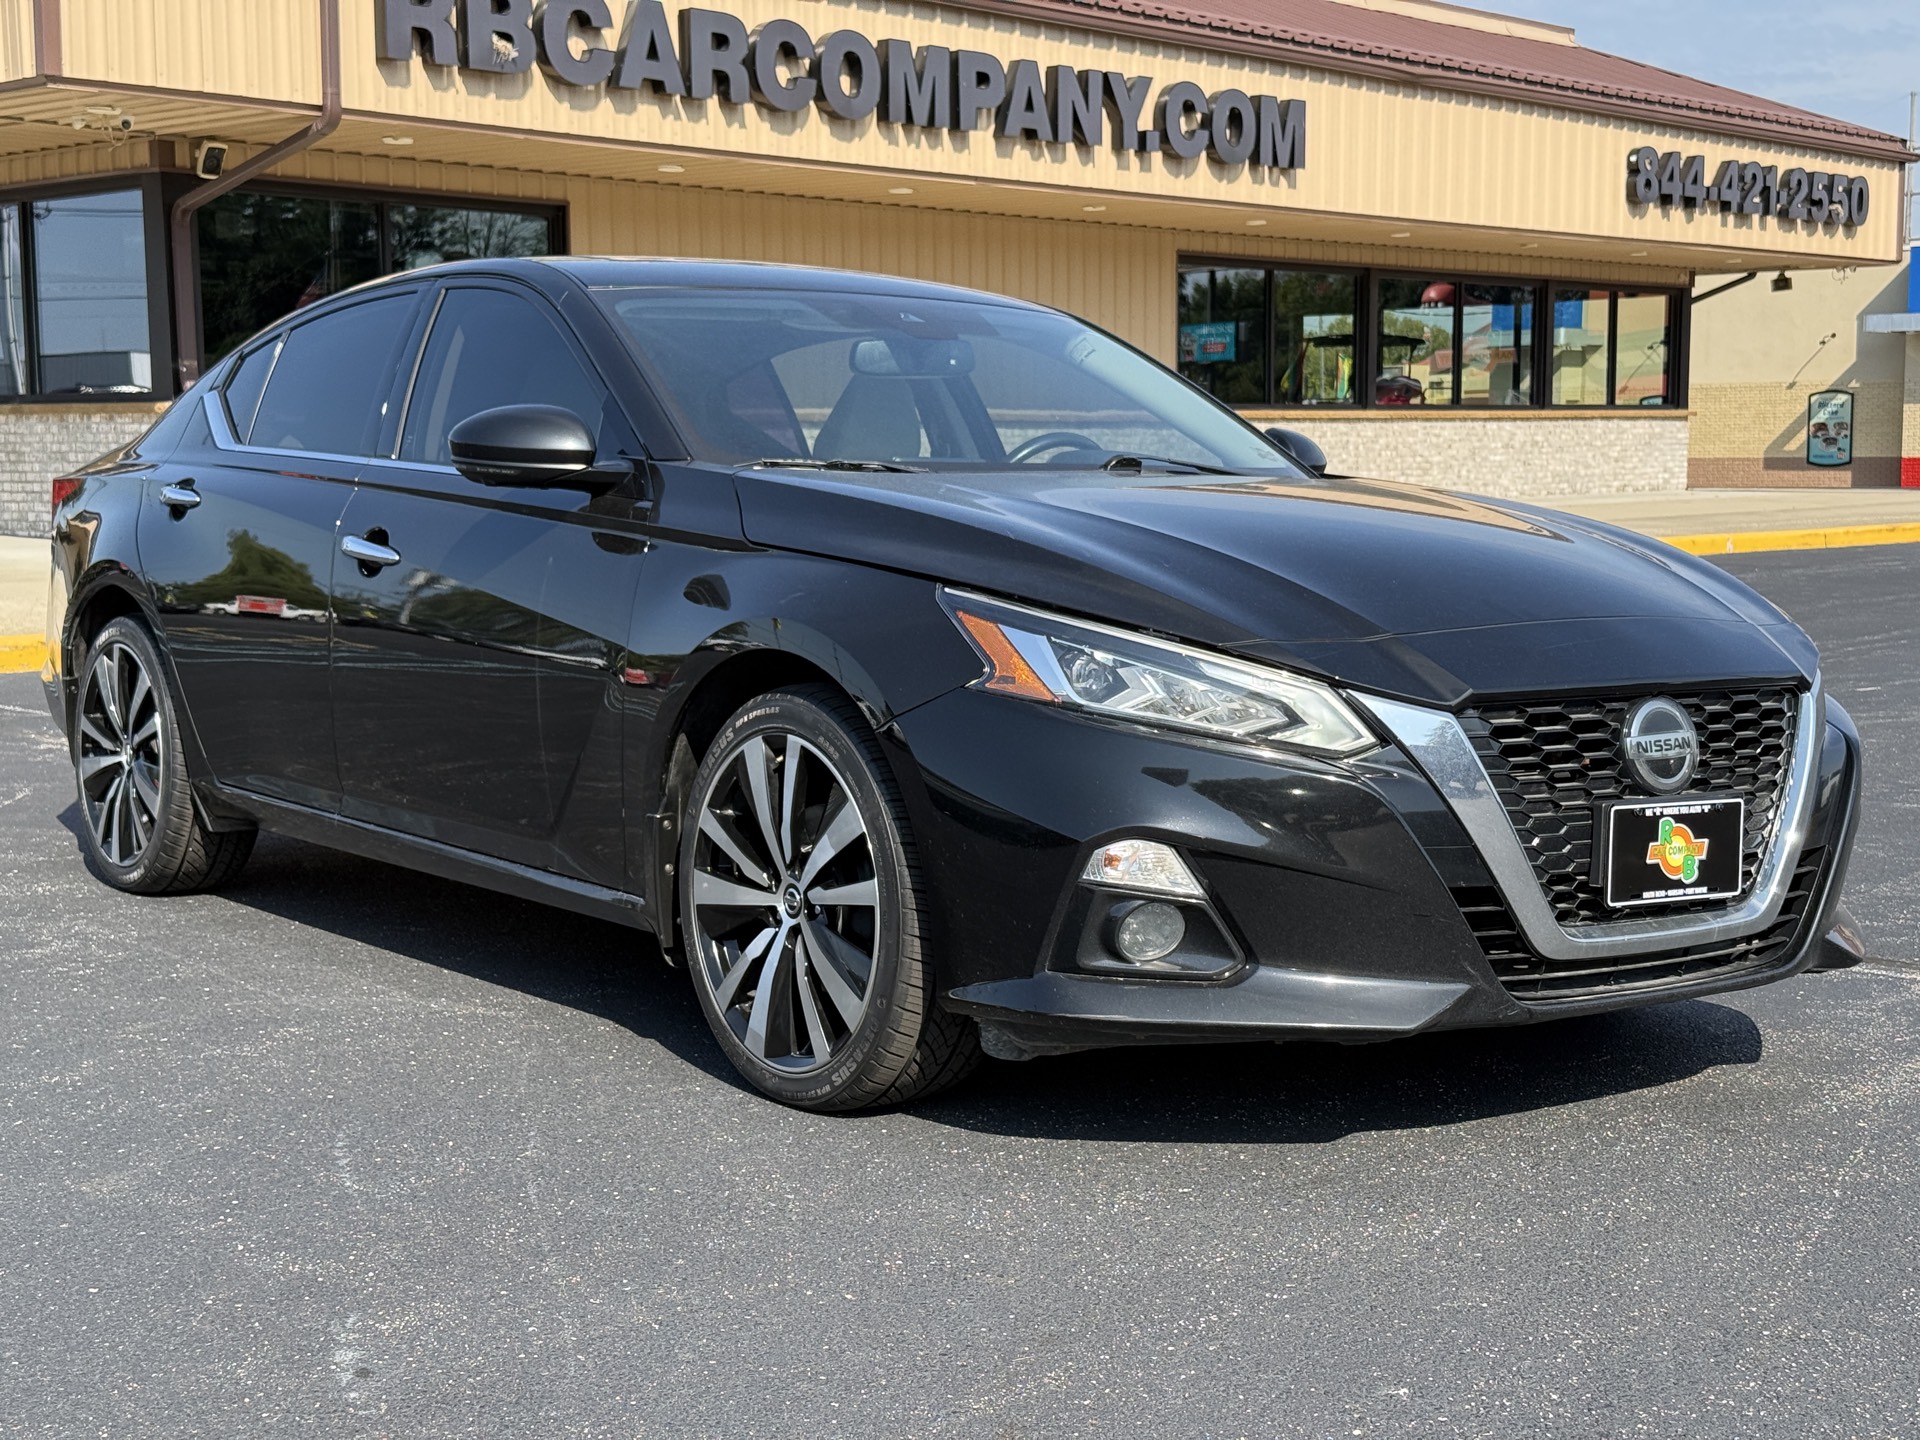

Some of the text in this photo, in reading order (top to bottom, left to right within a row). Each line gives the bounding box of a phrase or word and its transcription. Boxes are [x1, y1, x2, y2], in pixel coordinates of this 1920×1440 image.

[375, 0, 1306, 170] RBCARCOMPANY.COM
[1636, 735, 1691, 754] NISSAN
[1668, 844, 1700, 856] COMPANY
